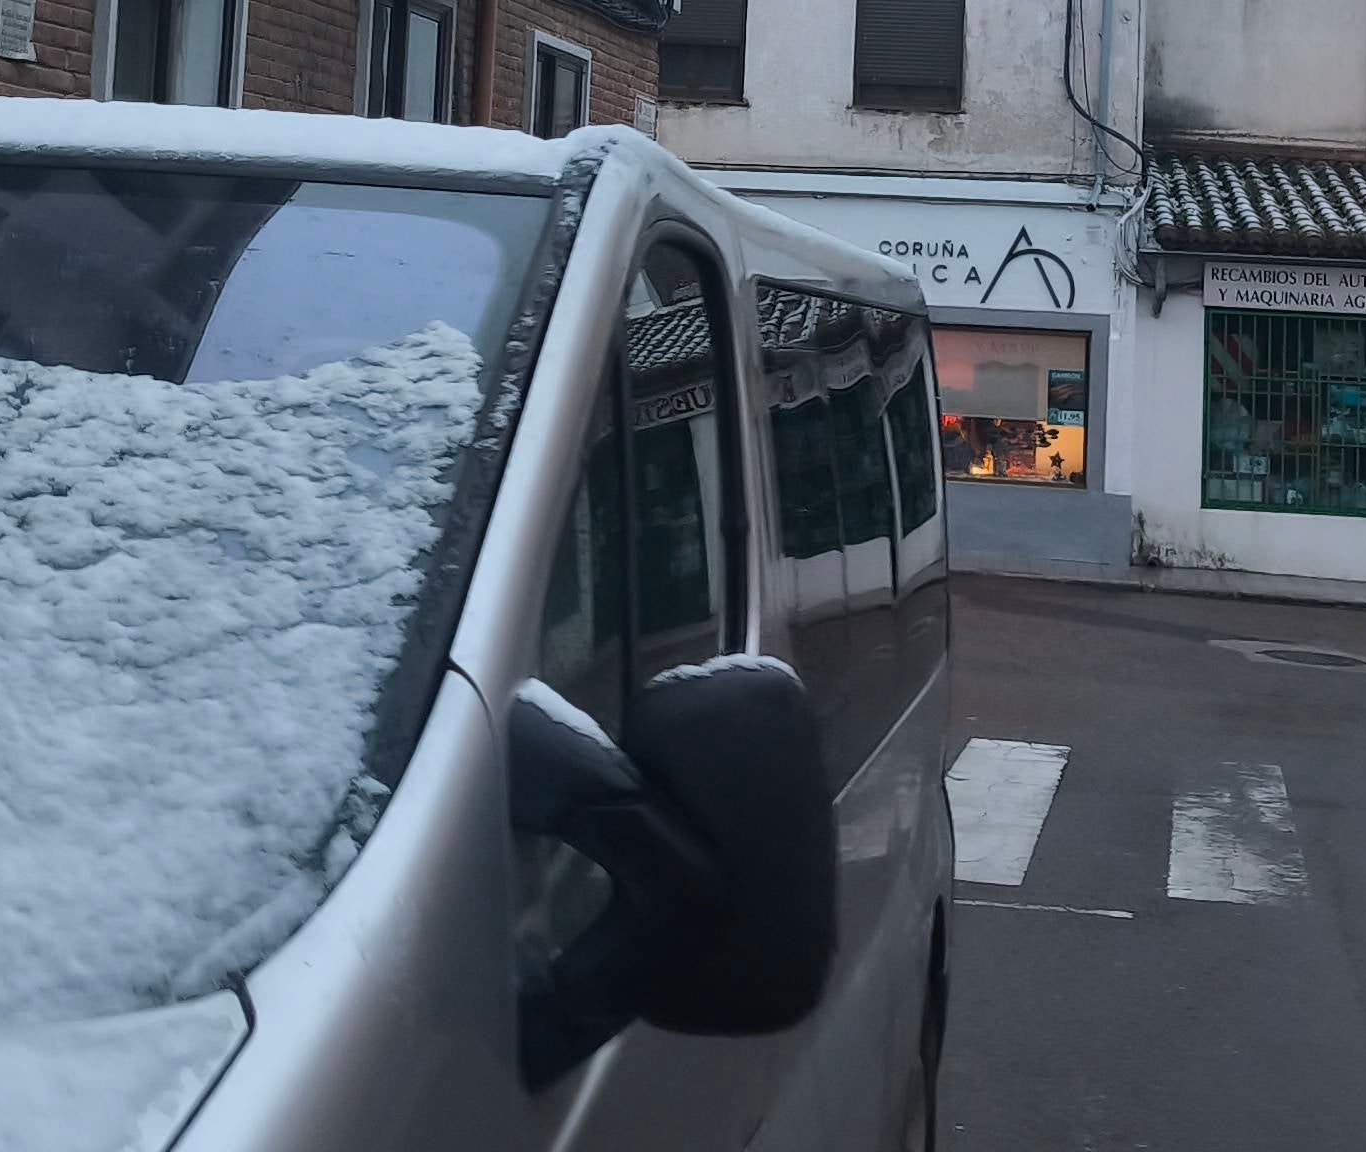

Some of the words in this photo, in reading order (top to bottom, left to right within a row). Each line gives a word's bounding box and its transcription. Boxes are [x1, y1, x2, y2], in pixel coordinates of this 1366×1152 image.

[878, 239, 969, 259] CORUÑA
[1210, 266, 1297, 285] RECAMBIOS
[1303, 272, 1330, 287] DEL
[1218, 288, 1228, 301] Y
[1235, 289, 1335, 307] MAQUINARIA
